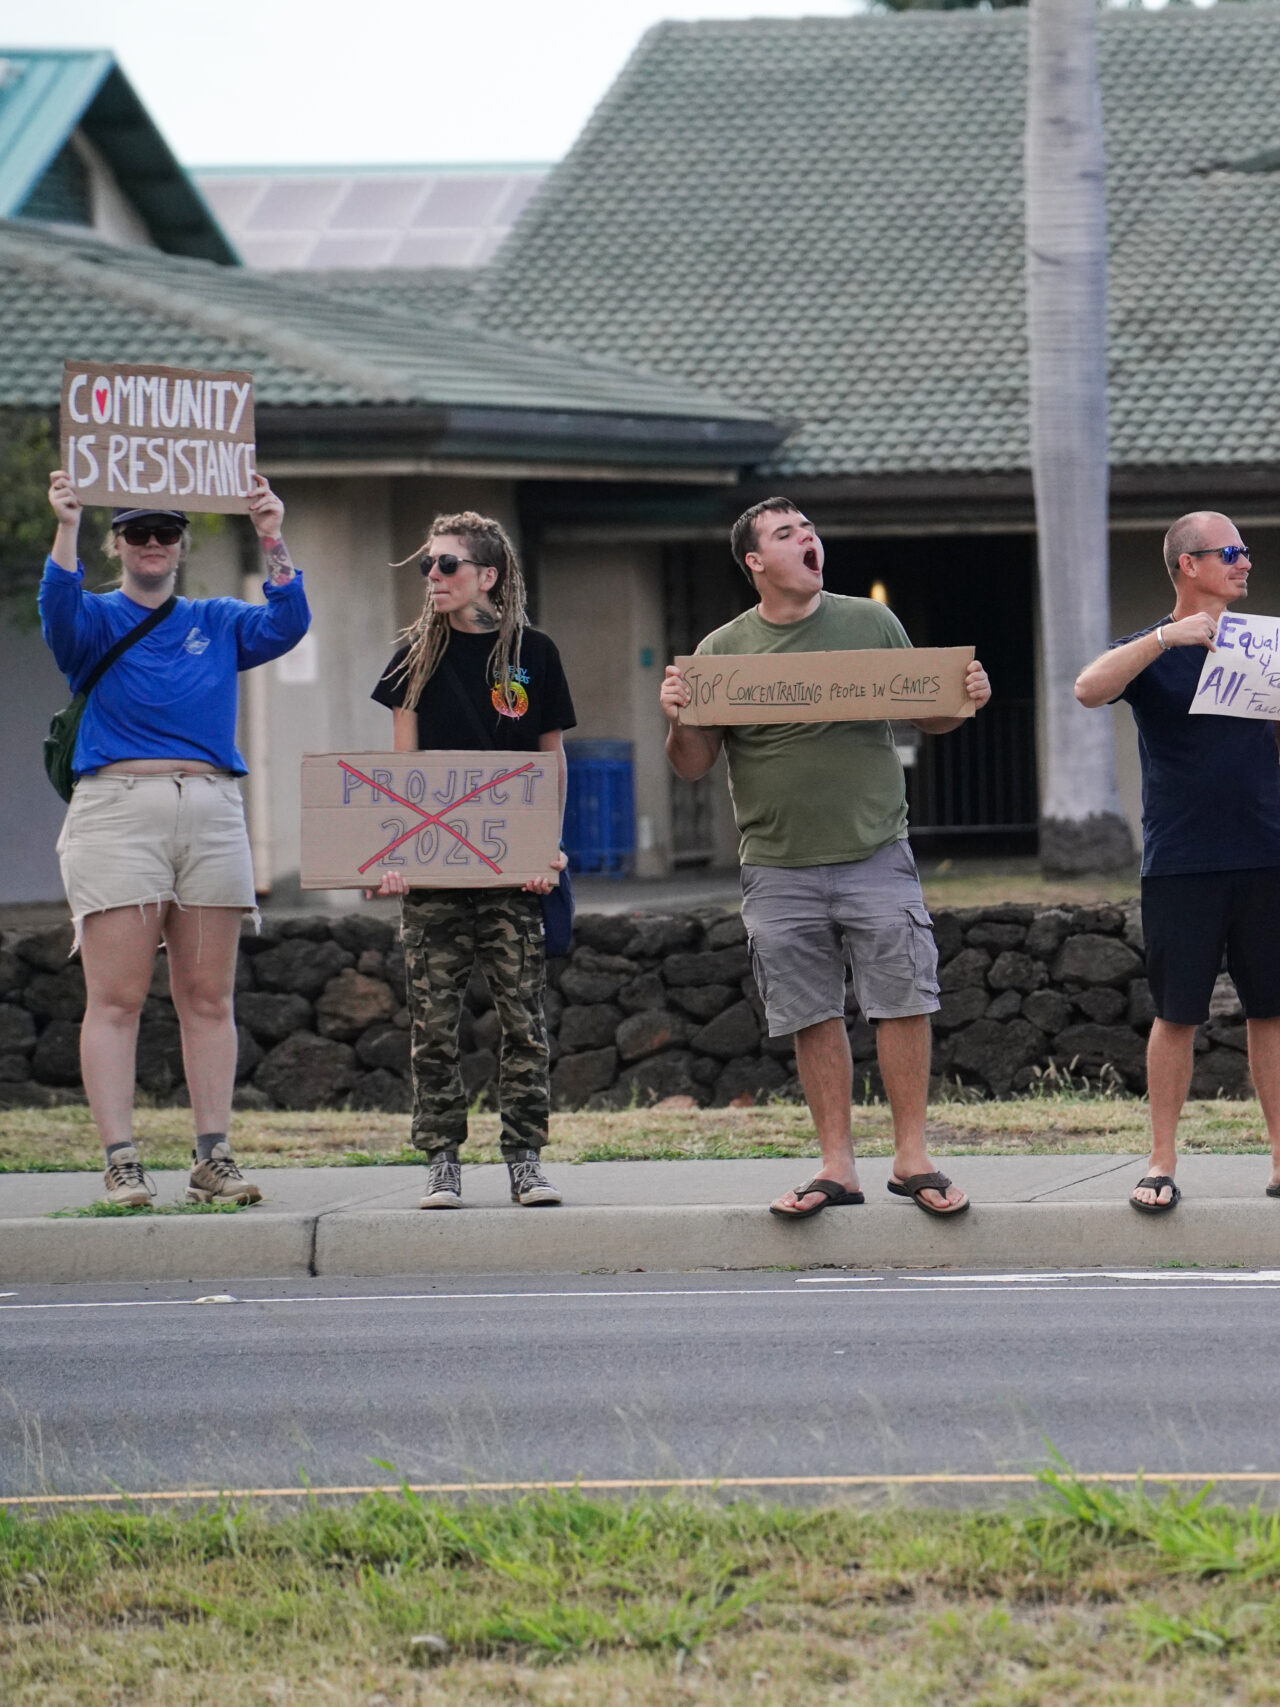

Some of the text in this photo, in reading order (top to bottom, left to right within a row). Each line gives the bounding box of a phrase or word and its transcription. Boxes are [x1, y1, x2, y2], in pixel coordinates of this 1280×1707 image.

[68, 374, 250, 434] COMMUNITY
[68, 434, 255, 497] IS RESISTANCE
[1215, 615, 1279, 659] Equal
[1258, 652, 1272, 676] 4
[682, 666, 723, 709] STOP
[829, 682, 866, 701] PEOPLE
[872, 682, 886, 698] IN
[342, 767, 545, 806] PROJECT
[379, 817, 509, 867] 2025
